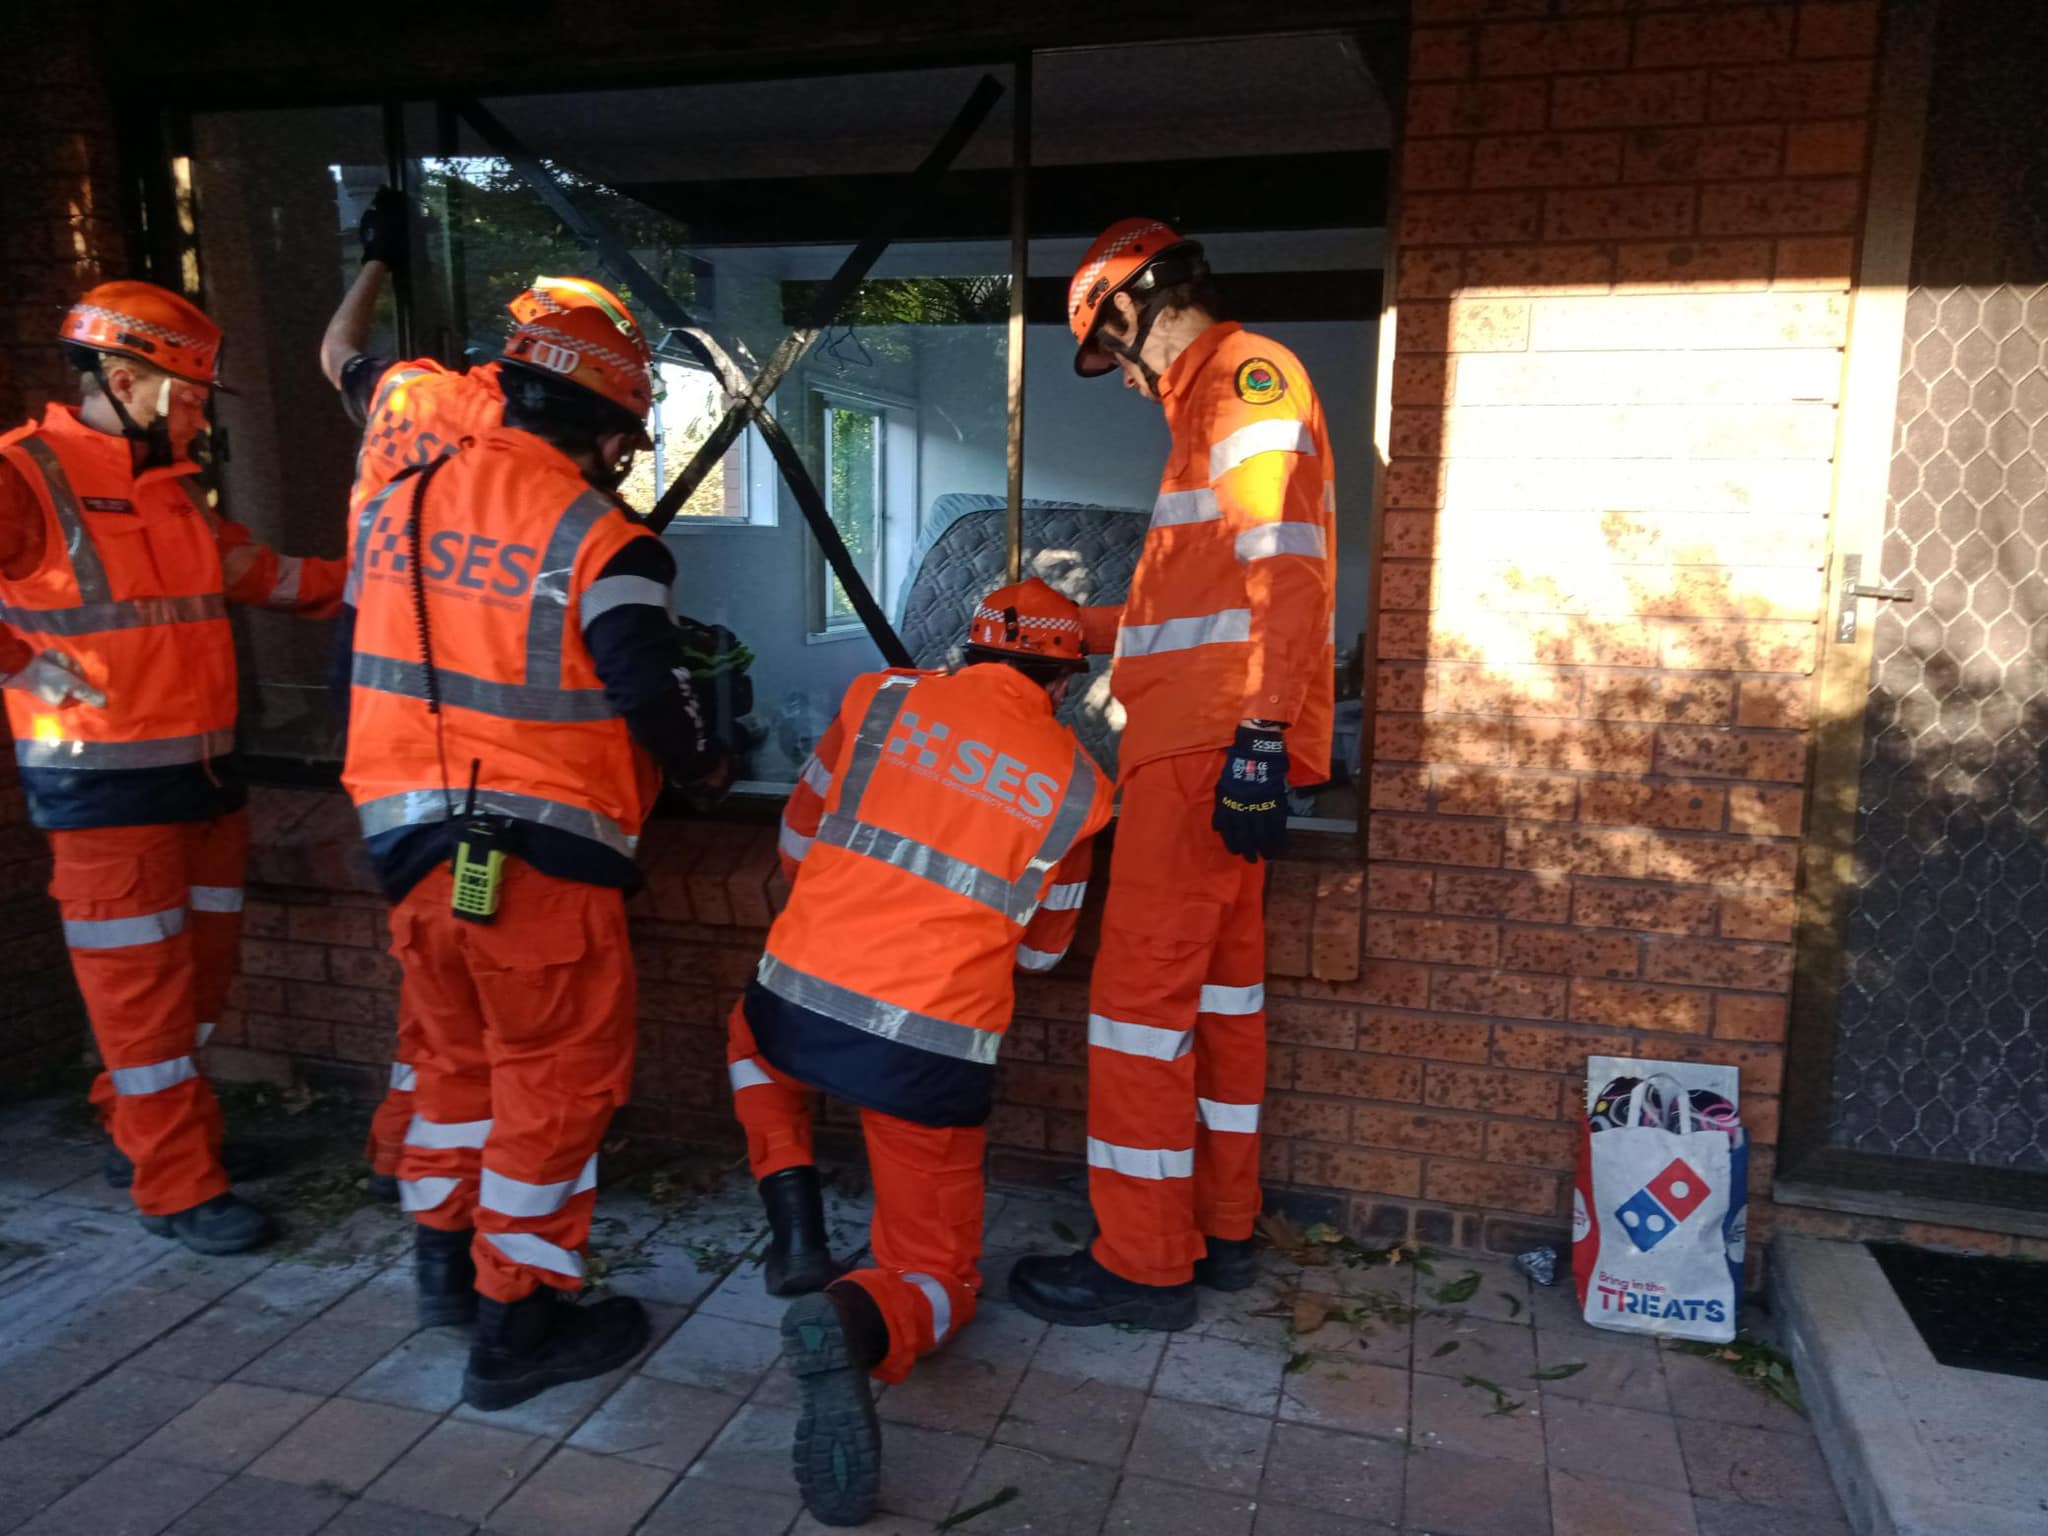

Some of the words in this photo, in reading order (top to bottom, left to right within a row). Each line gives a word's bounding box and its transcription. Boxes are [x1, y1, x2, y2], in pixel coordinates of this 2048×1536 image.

[423, 530, 536, 598] SES
[950, 740, 1060, 817] SES
[1222, 796, 1277, 812] MEC-FLEX
[1599, 1270, 1629, 1290] Bring
[1631, 1279, 1643, 1290] in
[1645, 1281, 1666, 1292] the
[1597, 1285, 1725, 1323] TREATS
